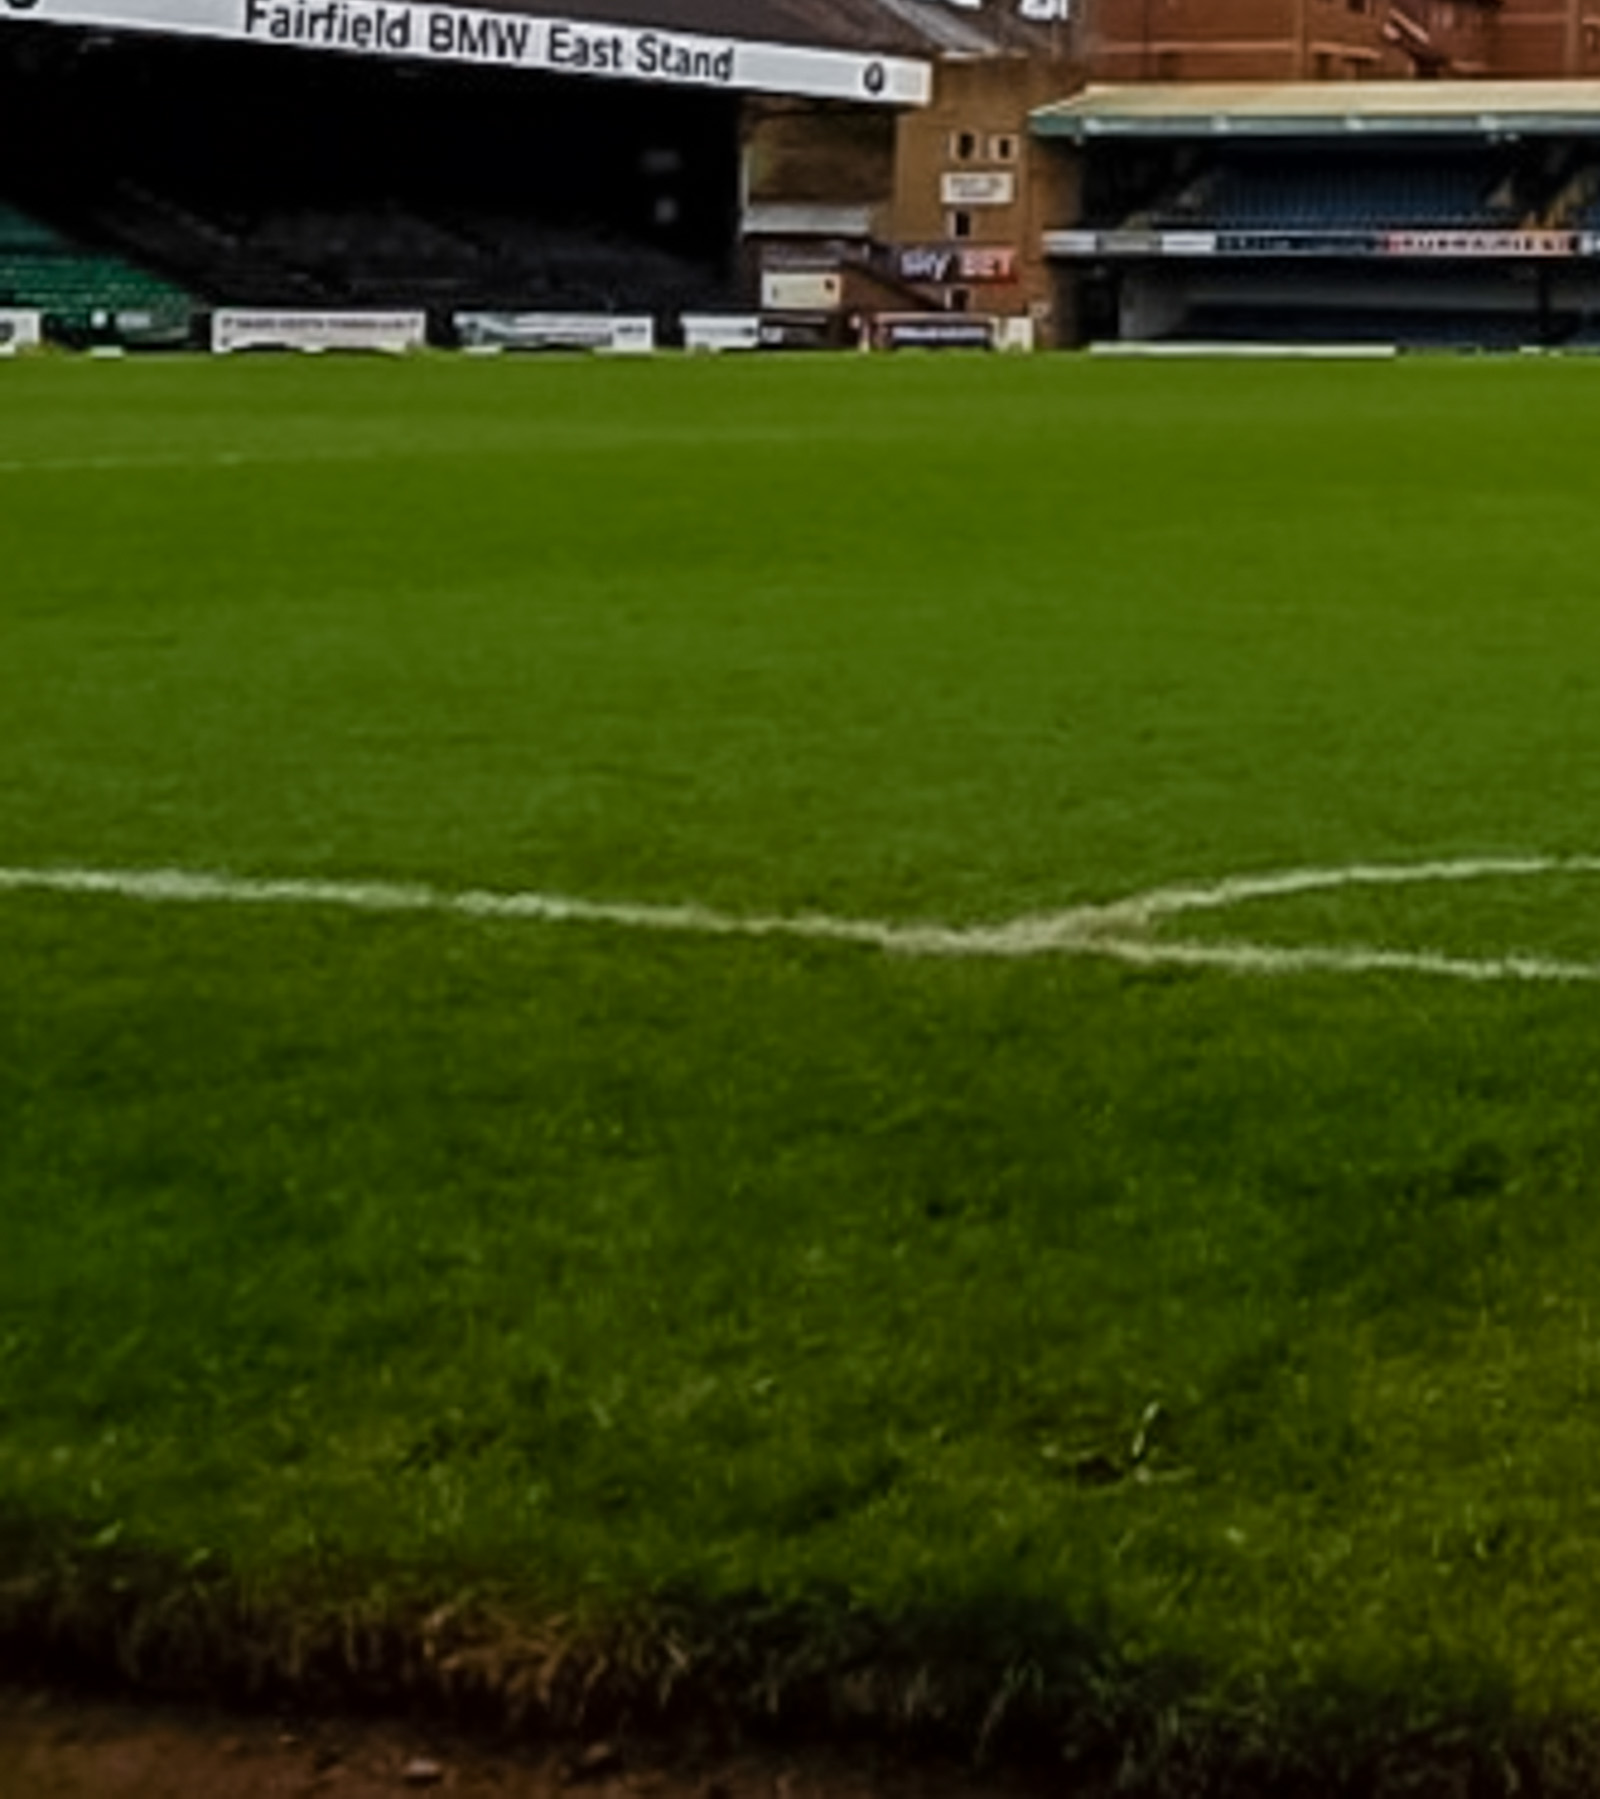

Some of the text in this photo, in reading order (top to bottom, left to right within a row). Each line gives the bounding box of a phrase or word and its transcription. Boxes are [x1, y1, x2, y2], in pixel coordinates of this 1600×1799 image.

[430, 13, 530, 58] BMW
[548, 25, 622, 70] East
[637, 32, 735, 82] Stand
